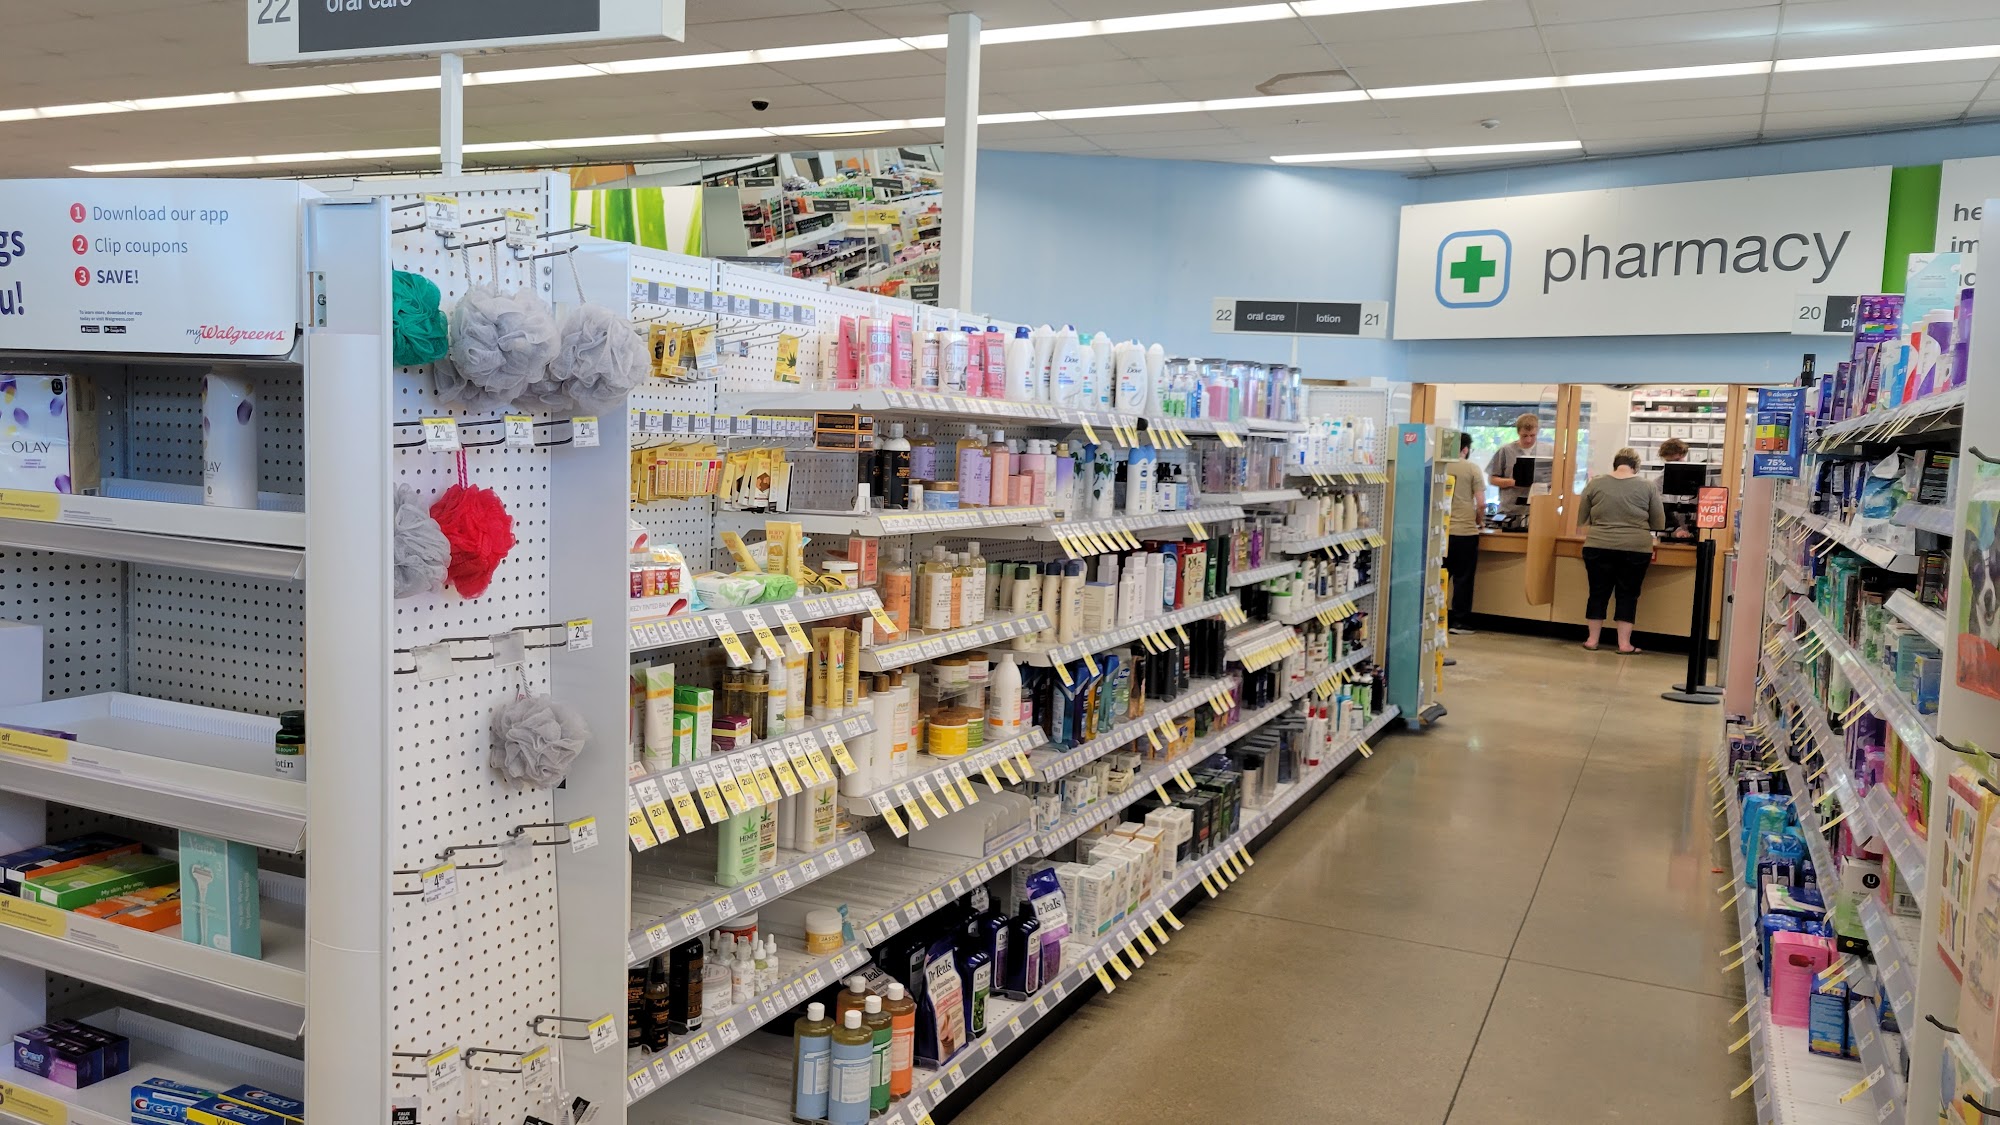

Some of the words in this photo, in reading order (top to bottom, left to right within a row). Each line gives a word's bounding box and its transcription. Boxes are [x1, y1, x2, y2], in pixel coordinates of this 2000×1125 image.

[93, 205, 166, 221] Download
[171, 208, 196, 221] our
[200, 208, 229, 226] app
[95, 238, 122, 257] Clip
[125, 240, 189, 257] coupons
[1543, 230, 1851, 295] pharmacy
[97, 269, 140, 285] SAVE!
[1216, 309, 1232, 321] 22
[1247, 312, 1264, 321] oral
[1265, 313, 1285, 322] care
[1316, 314, 1341, 323] lotion
[1364, 313, 1380, 325] 21
[1799, 306, 1821, 320] 20
[11, 440, 52, 454] OLAY
[1700, 504, 1724, 514] wait
[1700, 513, 1725, 523] here
[2, 733, 11, 741] off
[815, 803, 834, 813] HEMPZ
[740, 831, 759, 843] HEMPZ
[110, 886, 122, 894] skin.
[132, 881, 145, 889] way.
[19, 1046, 45, 1064] Crest
[5, 1089, 13, 1098] off
[244, 1091, 299, 1109] Crest
[134, 1098, 179, 1117] Crest
[214, 1102, 270, 1122] Crest
